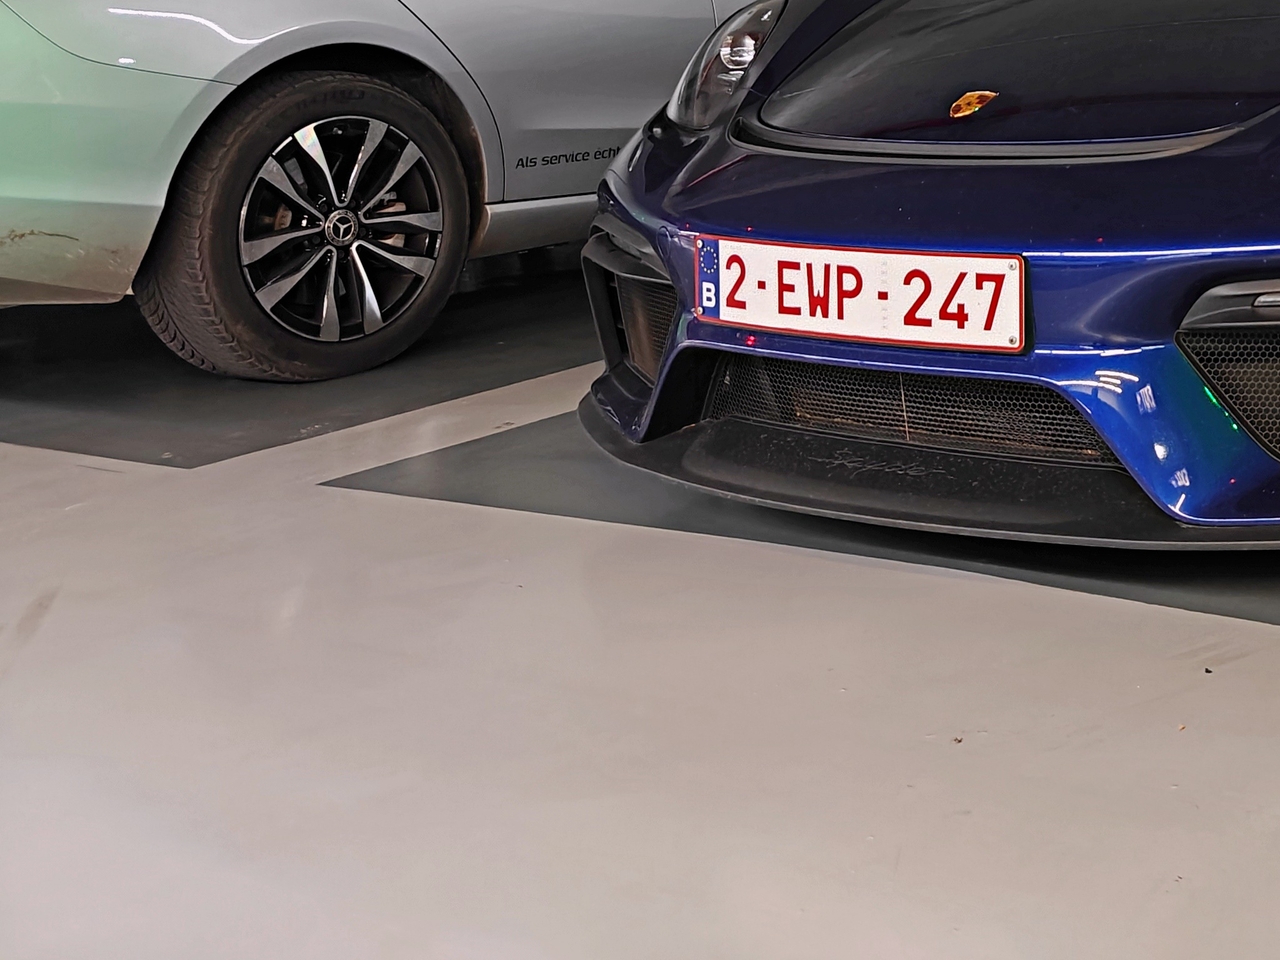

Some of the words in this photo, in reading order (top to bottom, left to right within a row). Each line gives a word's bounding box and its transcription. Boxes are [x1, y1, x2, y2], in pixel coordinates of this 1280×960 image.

[515, 156, 537, 169] Als
[541, 150, 590, 167] service
[702, 281, 717, 308] B
[725, 254, 1006, 331] 2-EWP-247
